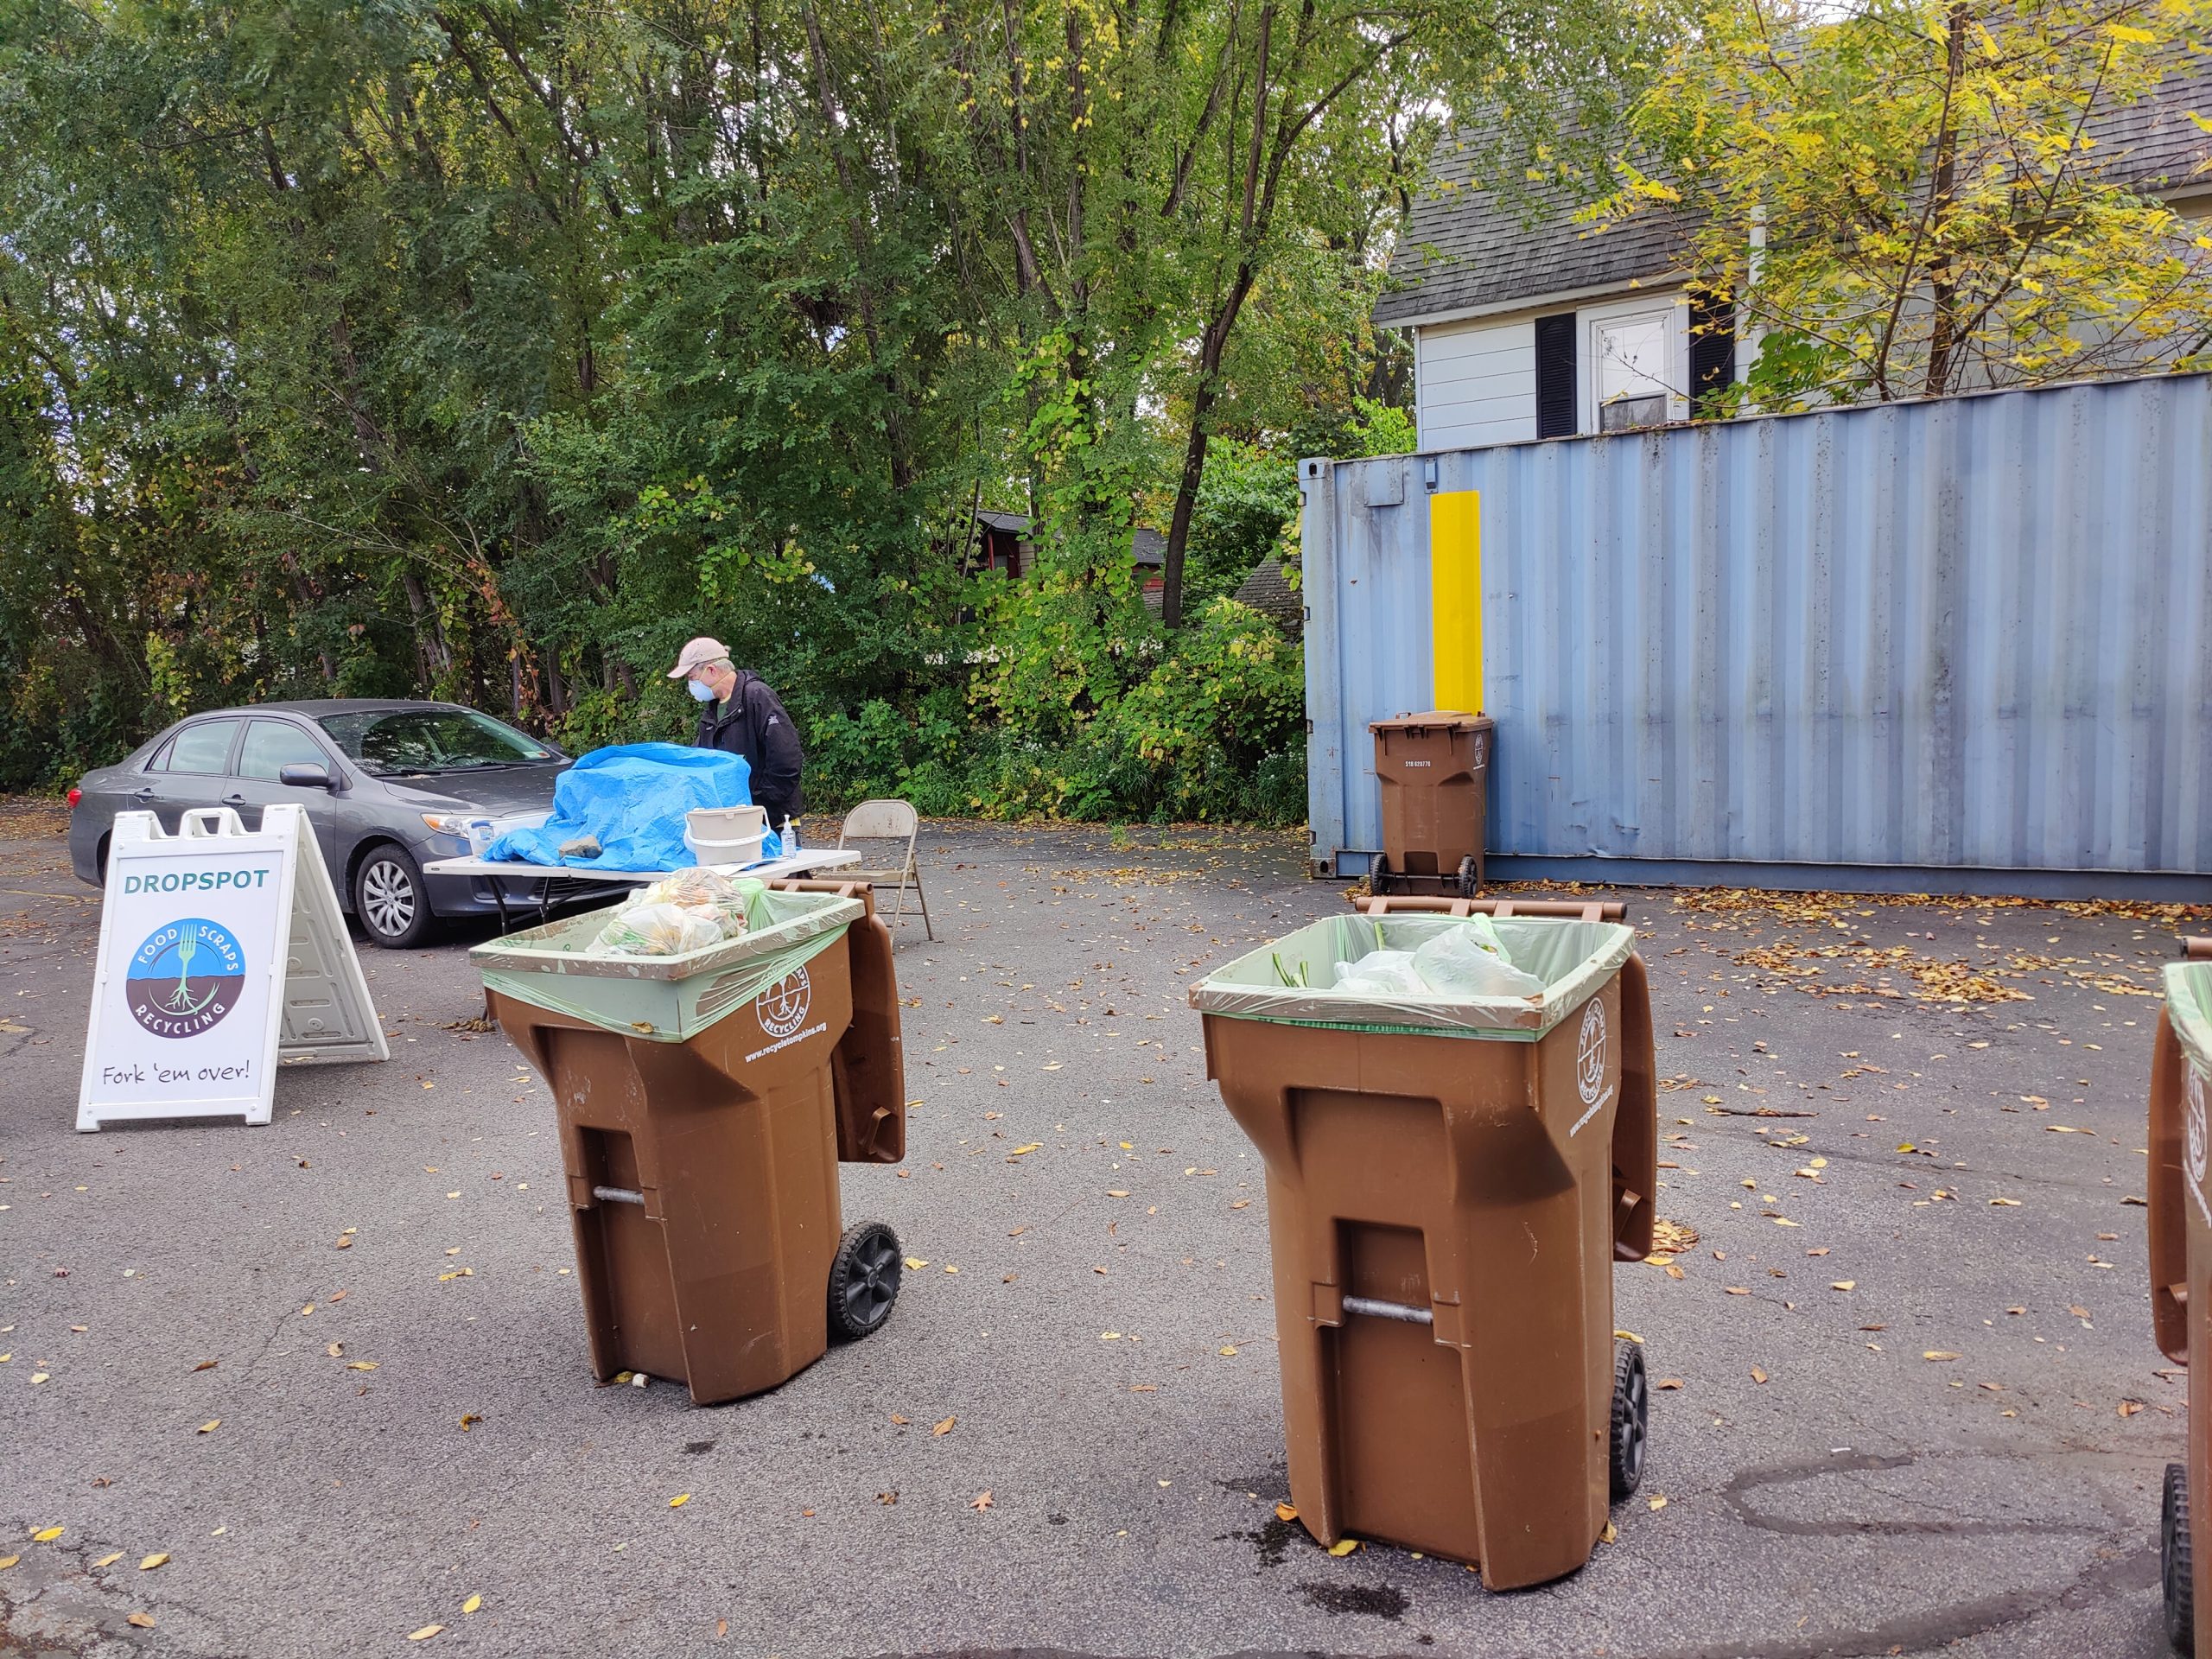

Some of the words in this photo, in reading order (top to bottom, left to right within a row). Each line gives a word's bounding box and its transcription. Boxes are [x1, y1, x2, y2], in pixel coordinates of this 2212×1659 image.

[124, 869, 270, 894] DROPSPOT
[137, 929, 177, 964] FOOD
[198, 926, 238, 971] SCRAPS
[136, 1002, 226, 1034] RECYCLING
[764, 1007, 805, 1033] RECYCLING
[745, 1022, 827, 1063] www.recycletompkins.org
[103, 1064, 146, 1084] Fork
[198, 1059, 250, 1081] over!
